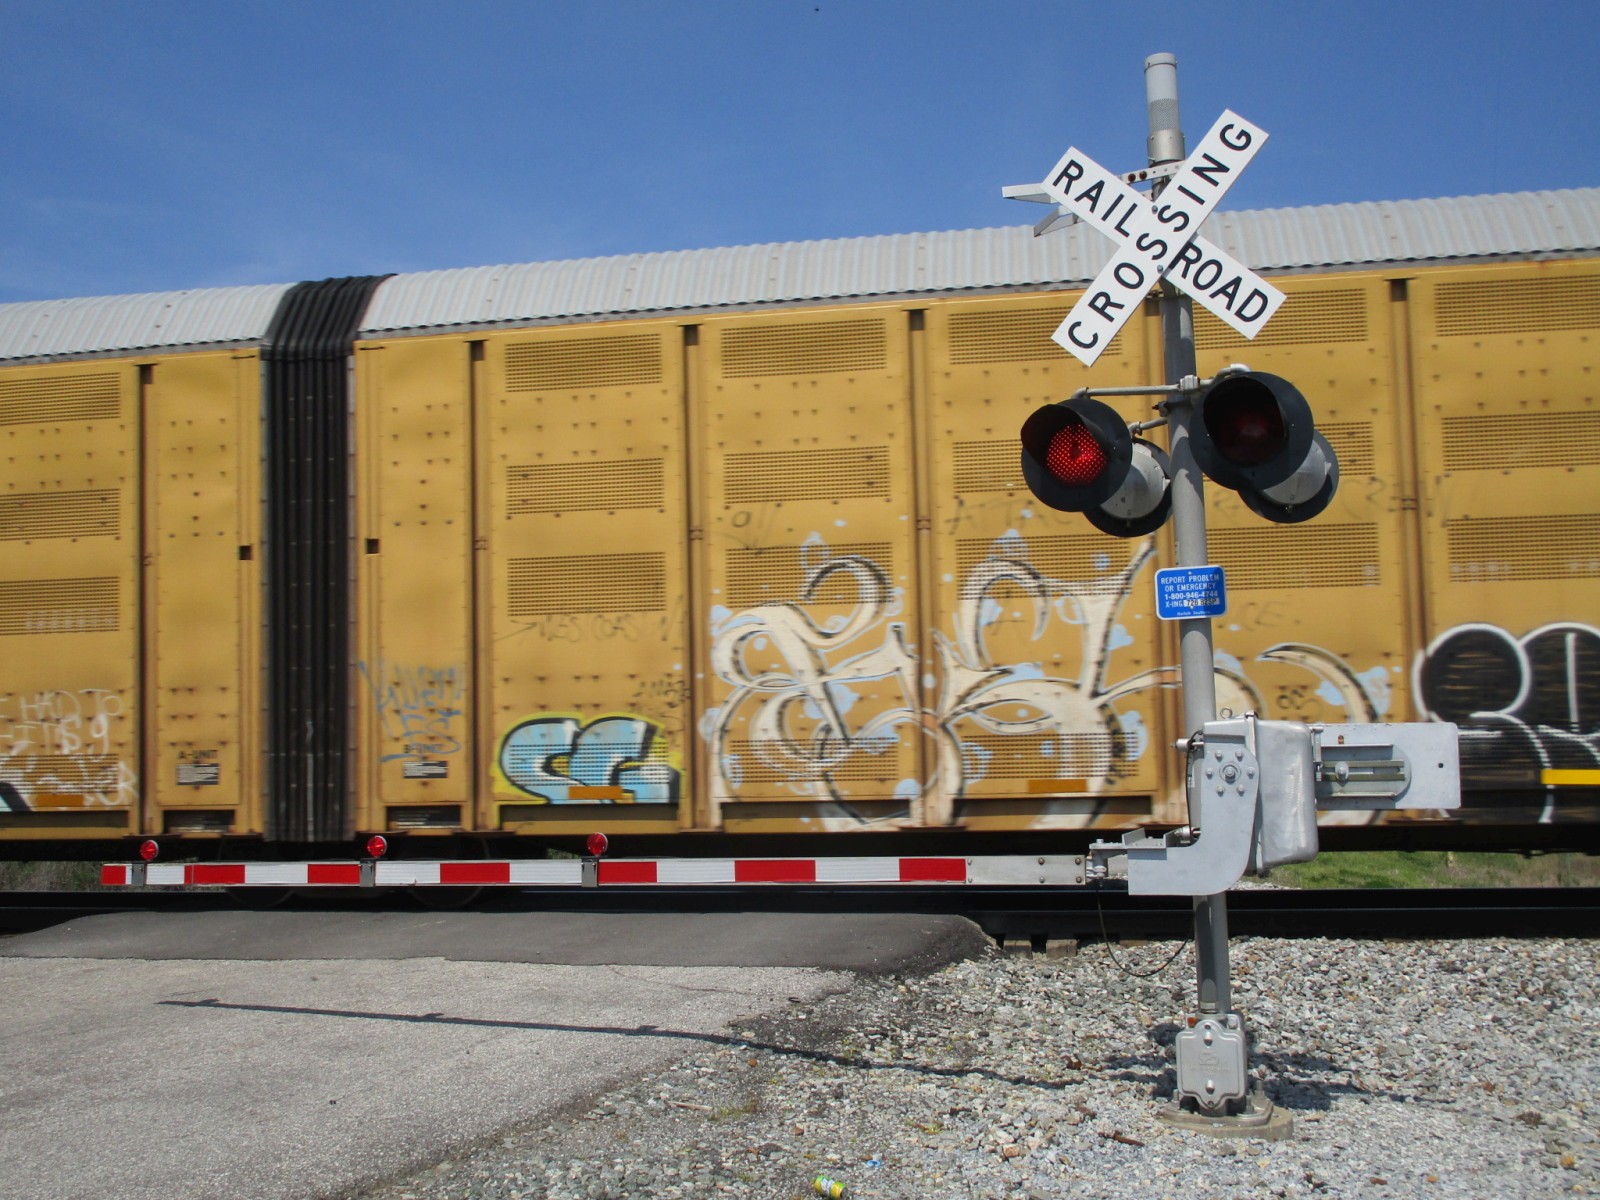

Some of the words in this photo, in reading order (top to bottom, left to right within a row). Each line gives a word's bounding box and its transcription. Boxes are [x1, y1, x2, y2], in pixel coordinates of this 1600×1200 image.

[1052, 159, 1138, 238] RAIL
[1168, 241, 1268, 323] ROAD
[1068, 123, 1252, 350] CROSSING
[1161, 576, 1186, 585] REPORT
[1188, 574, 1220, 583] PROBLEM
[1177, 582, 1217, 592] EMERGENCY
[1165, 600, 1183, 608] X-ING
